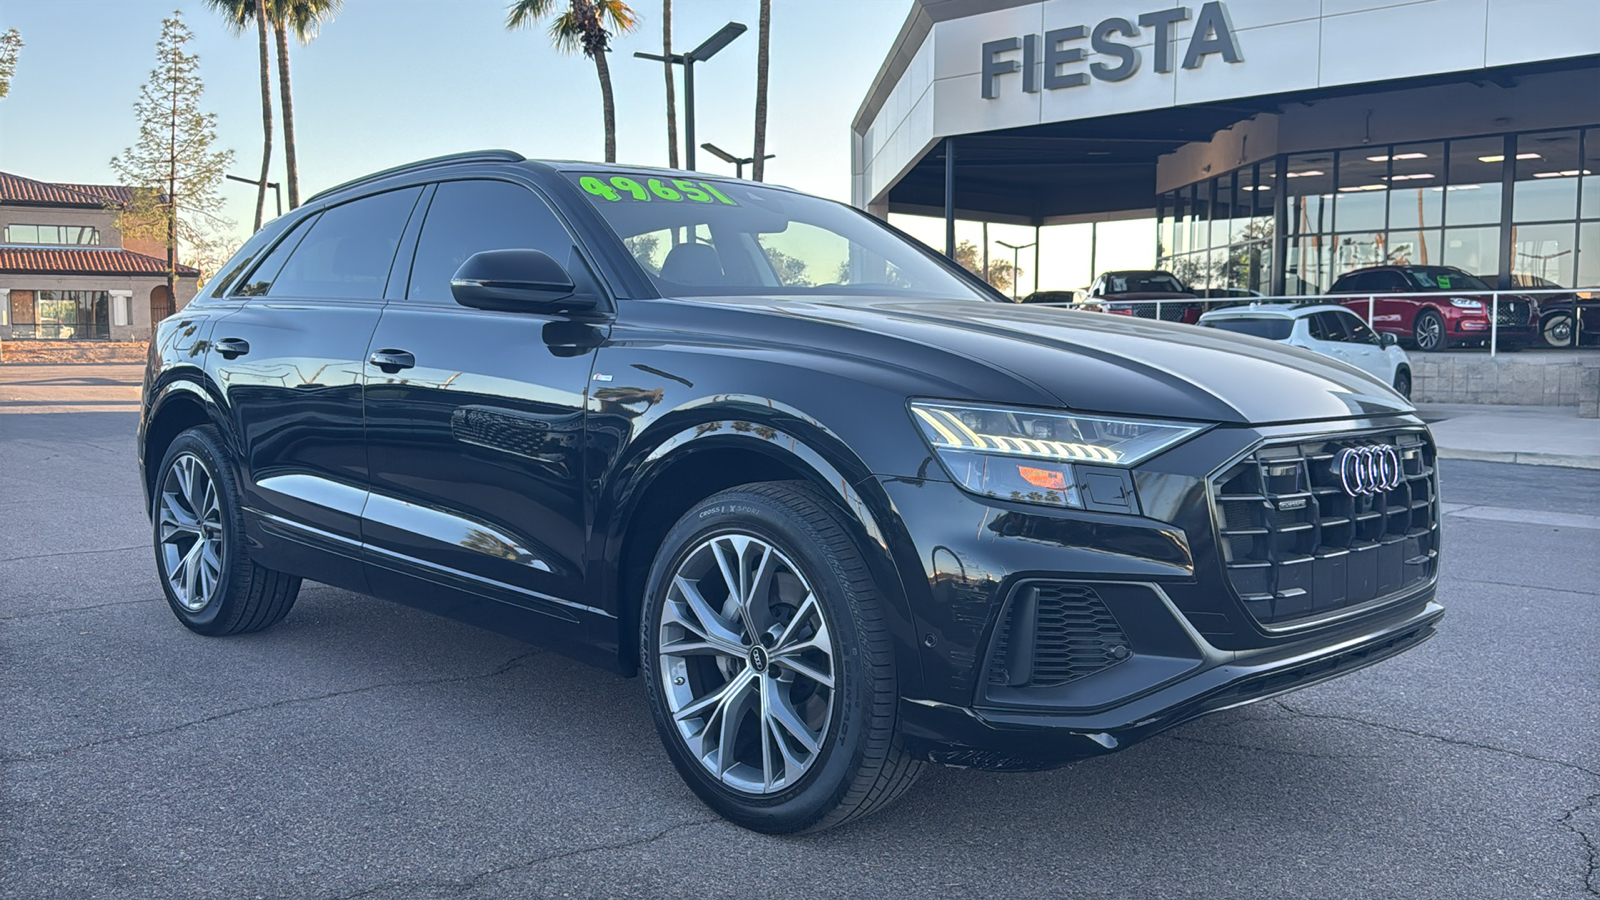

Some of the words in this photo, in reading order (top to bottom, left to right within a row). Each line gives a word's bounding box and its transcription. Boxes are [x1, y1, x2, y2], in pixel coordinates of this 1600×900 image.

[981, 1, 1244, 100] FIESTA
[579, 176, 738, 206] 49651
[699, 506, 720, 518] CROSS
